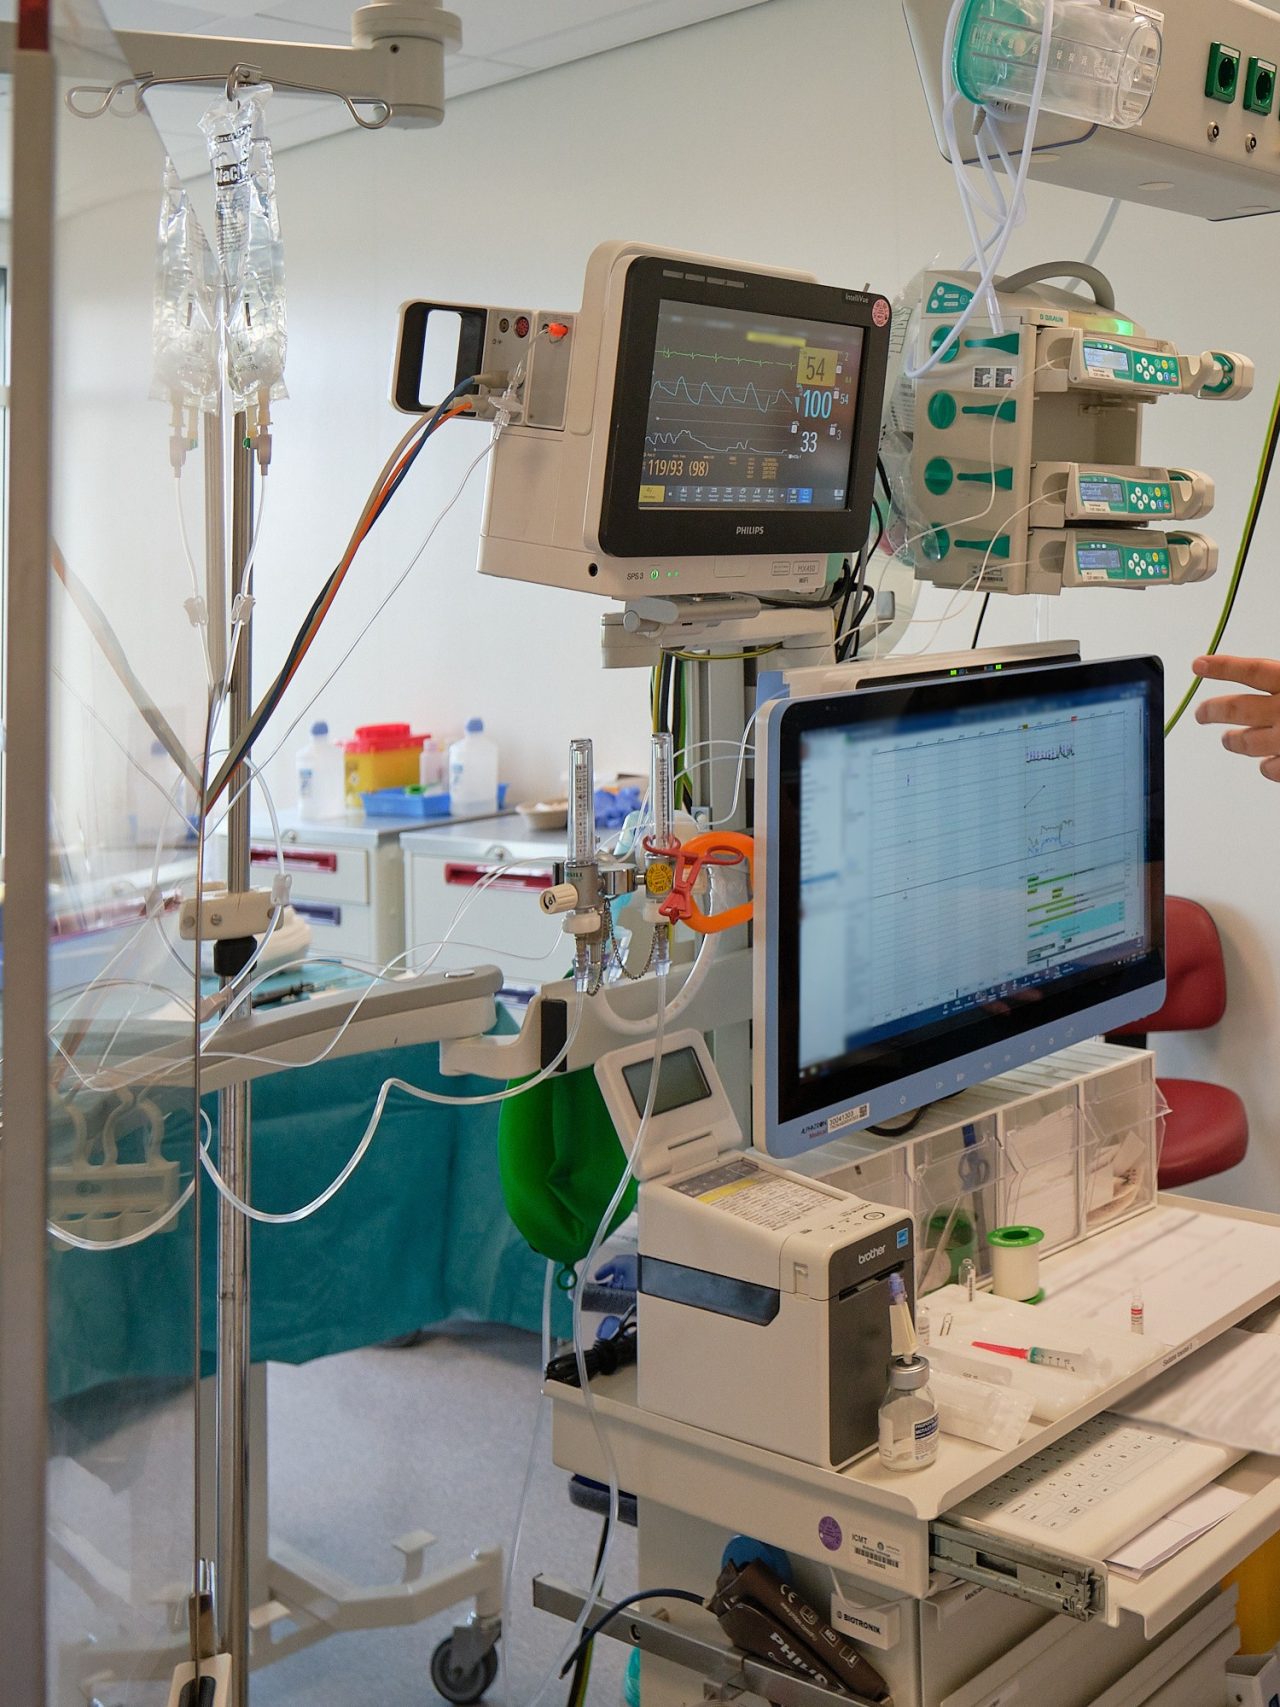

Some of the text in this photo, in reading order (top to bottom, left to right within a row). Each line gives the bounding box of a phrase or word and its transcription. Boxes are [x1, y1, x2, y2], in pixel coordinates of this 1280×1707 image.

[806, 355, 826, 382] 54
[803, 389, 832, 419] 100
[800, 431, 818, 453] 33
[647, 459, 684, 477] 119/93
[688, 460, 709, 477] (98)
[735, 526, 764, 535] PHILIPS
[858, 1244, 886, 1265] brother
[843, 1612, 882, 1635] BIOTRONIK
